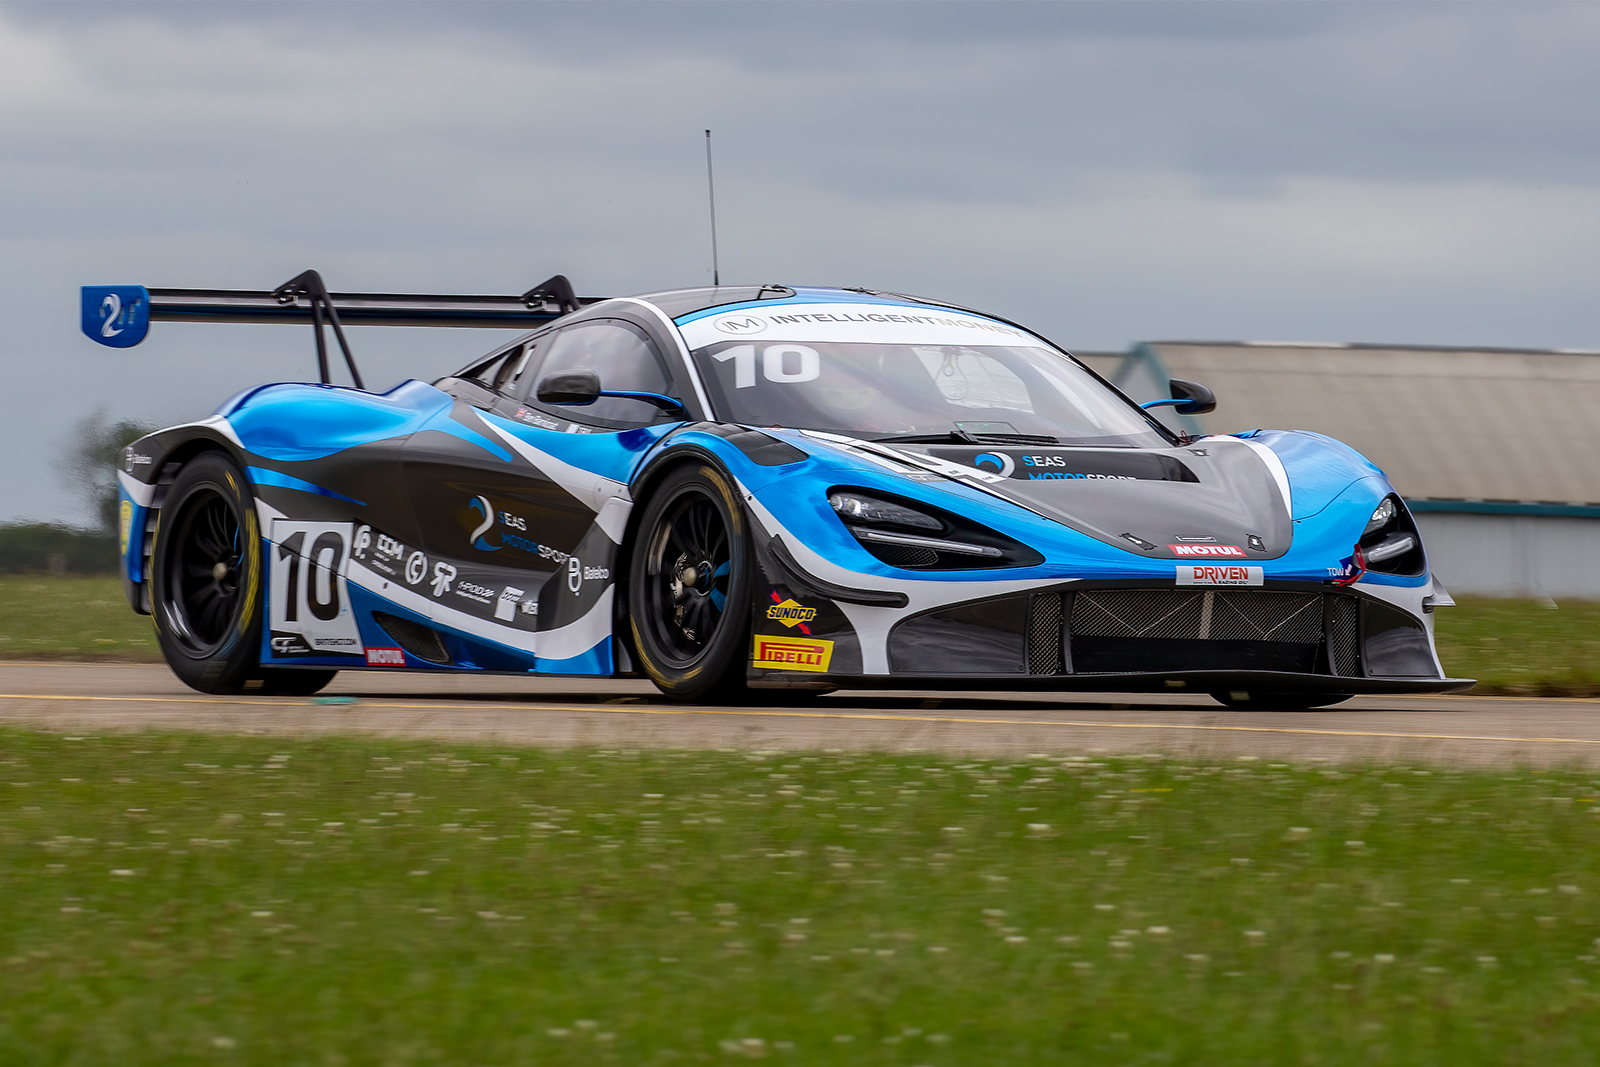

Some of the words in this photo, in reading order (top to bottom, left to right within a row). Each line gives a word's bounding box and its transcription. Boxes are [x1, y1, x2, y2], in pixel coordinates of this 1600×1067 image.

[712, 344, 821, 389] 10
[1022, 455, 1067, 467] SEAS
[1028, 472, 1136, 480] MOTORSP
[498, 510, 527, 532] SEAS
[1174, 545, 1243, 556] MOTUL
[278, 531, 344, 622] 10
[1193, 567, 1249, 584] DRIVEN
[1327, 567, 1344, 576] TOW
[769, 606, 815, 620] SUNOCO
[366, 649, 406, 664] MOTUL
[760, 641, 825, 666] PIRELLI
